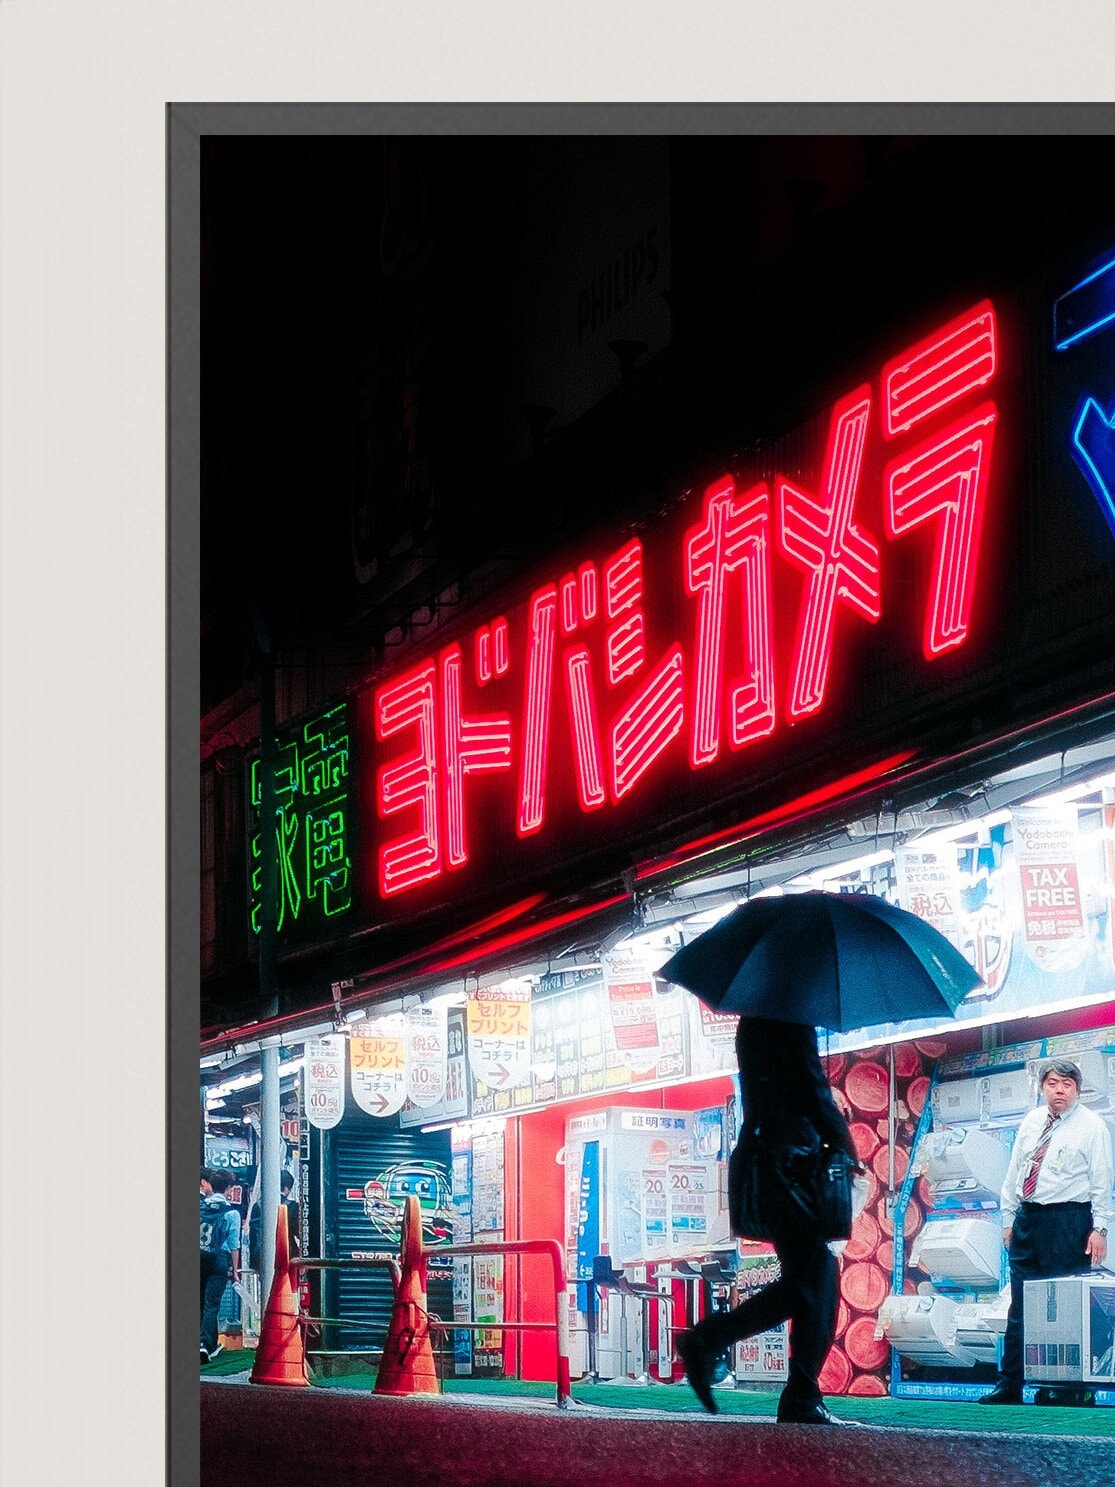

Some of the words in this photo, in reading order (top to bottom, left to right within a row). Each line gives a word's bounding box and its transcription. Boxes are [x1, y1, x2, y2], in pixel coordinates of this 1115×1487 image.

[577, 223, 660, 345] PHILIPS
[373, 298, 1000, 900] ヨドバシカメラ
[1025, 840, 1068, 851] Camera
[1028, 867, 1069, 887] TAX
[1025, 887, 1077, 906] FREE
[910, 892, 954, 918] 税込
[477, 1003, 521, 1019] セルフ
[470, 1019, 529, 1036] プリント
[360, 1039, 399, 1054] セルフ
[473, 1038, 526, 1050] コーナーは
[353, 1054, 406, 1069] プリント
[311, 1063, 339, 1079] 税込
[356, 1071, 404, 1081] コーナーは
[631, 1114, 688, 1130] 証明写真
